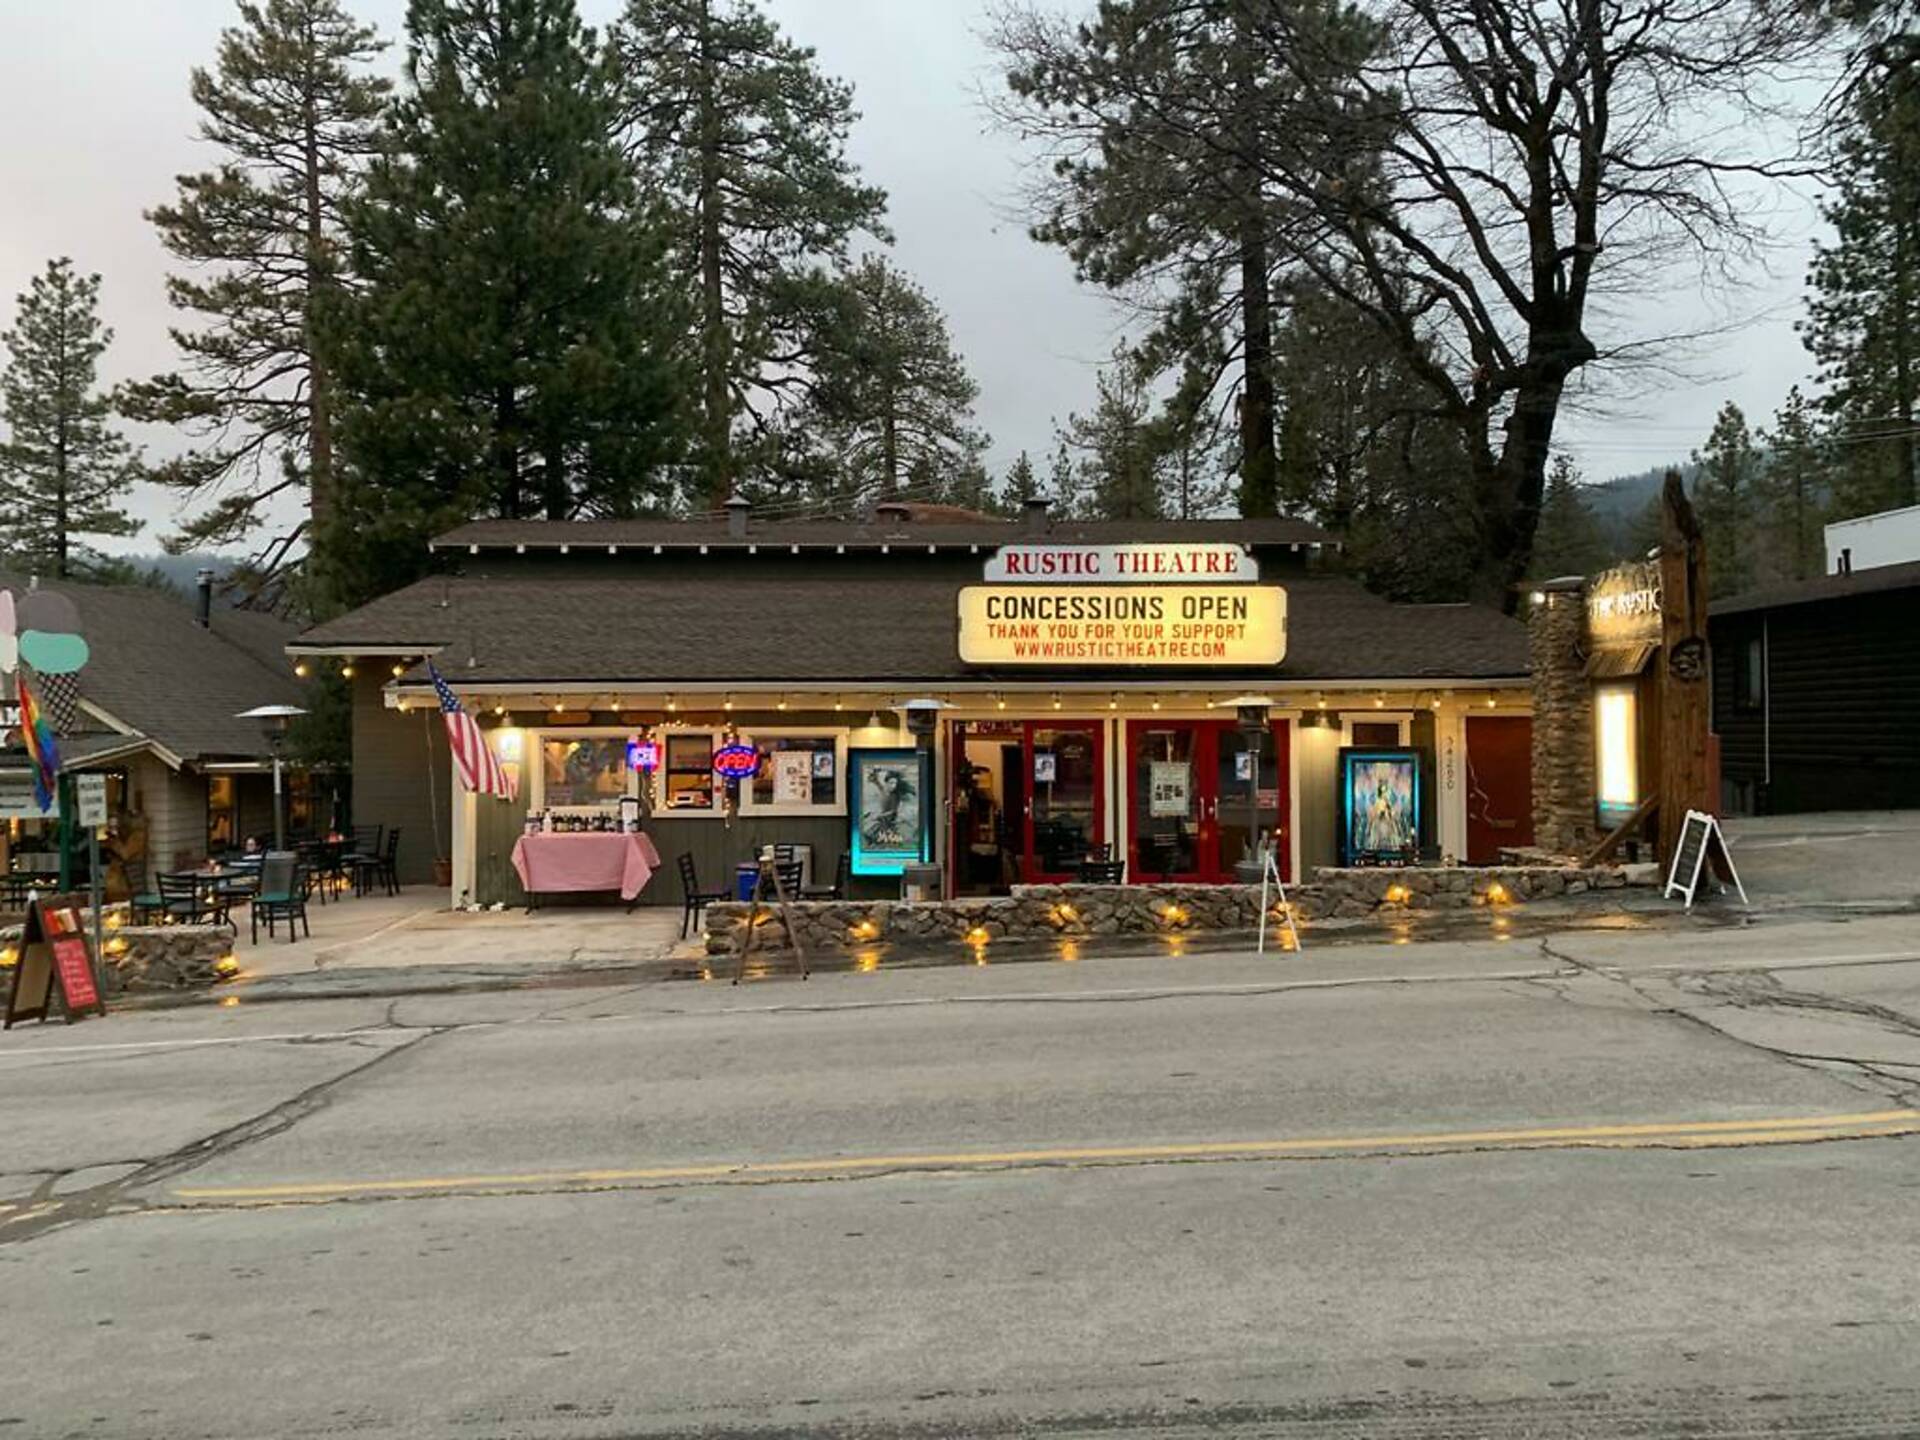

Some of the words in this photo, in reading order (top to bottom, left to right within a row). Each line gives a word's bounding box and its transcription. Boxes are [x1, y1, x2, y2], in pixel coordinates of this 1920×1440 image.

[1005, 552, 1100, 575] RUSTIC
[1114, 551, 1238, 574] THEATRE
[986, 596, 1164, 620] CONCESSIONS
[1182, 596, 1248, 620] OPEN
[1616, 587, 1661, 615] RUSTIC
[987, 624, 1040, 639] THANK
[1048, 624, 1078, 639] YOU
[1084, 624, 1115, 639] FOR
[1122, 624, 1164, 639] YOUR
[1171, 624, 1246, 639] SUPPORT
[713, 752, 758, 771] OPEN
